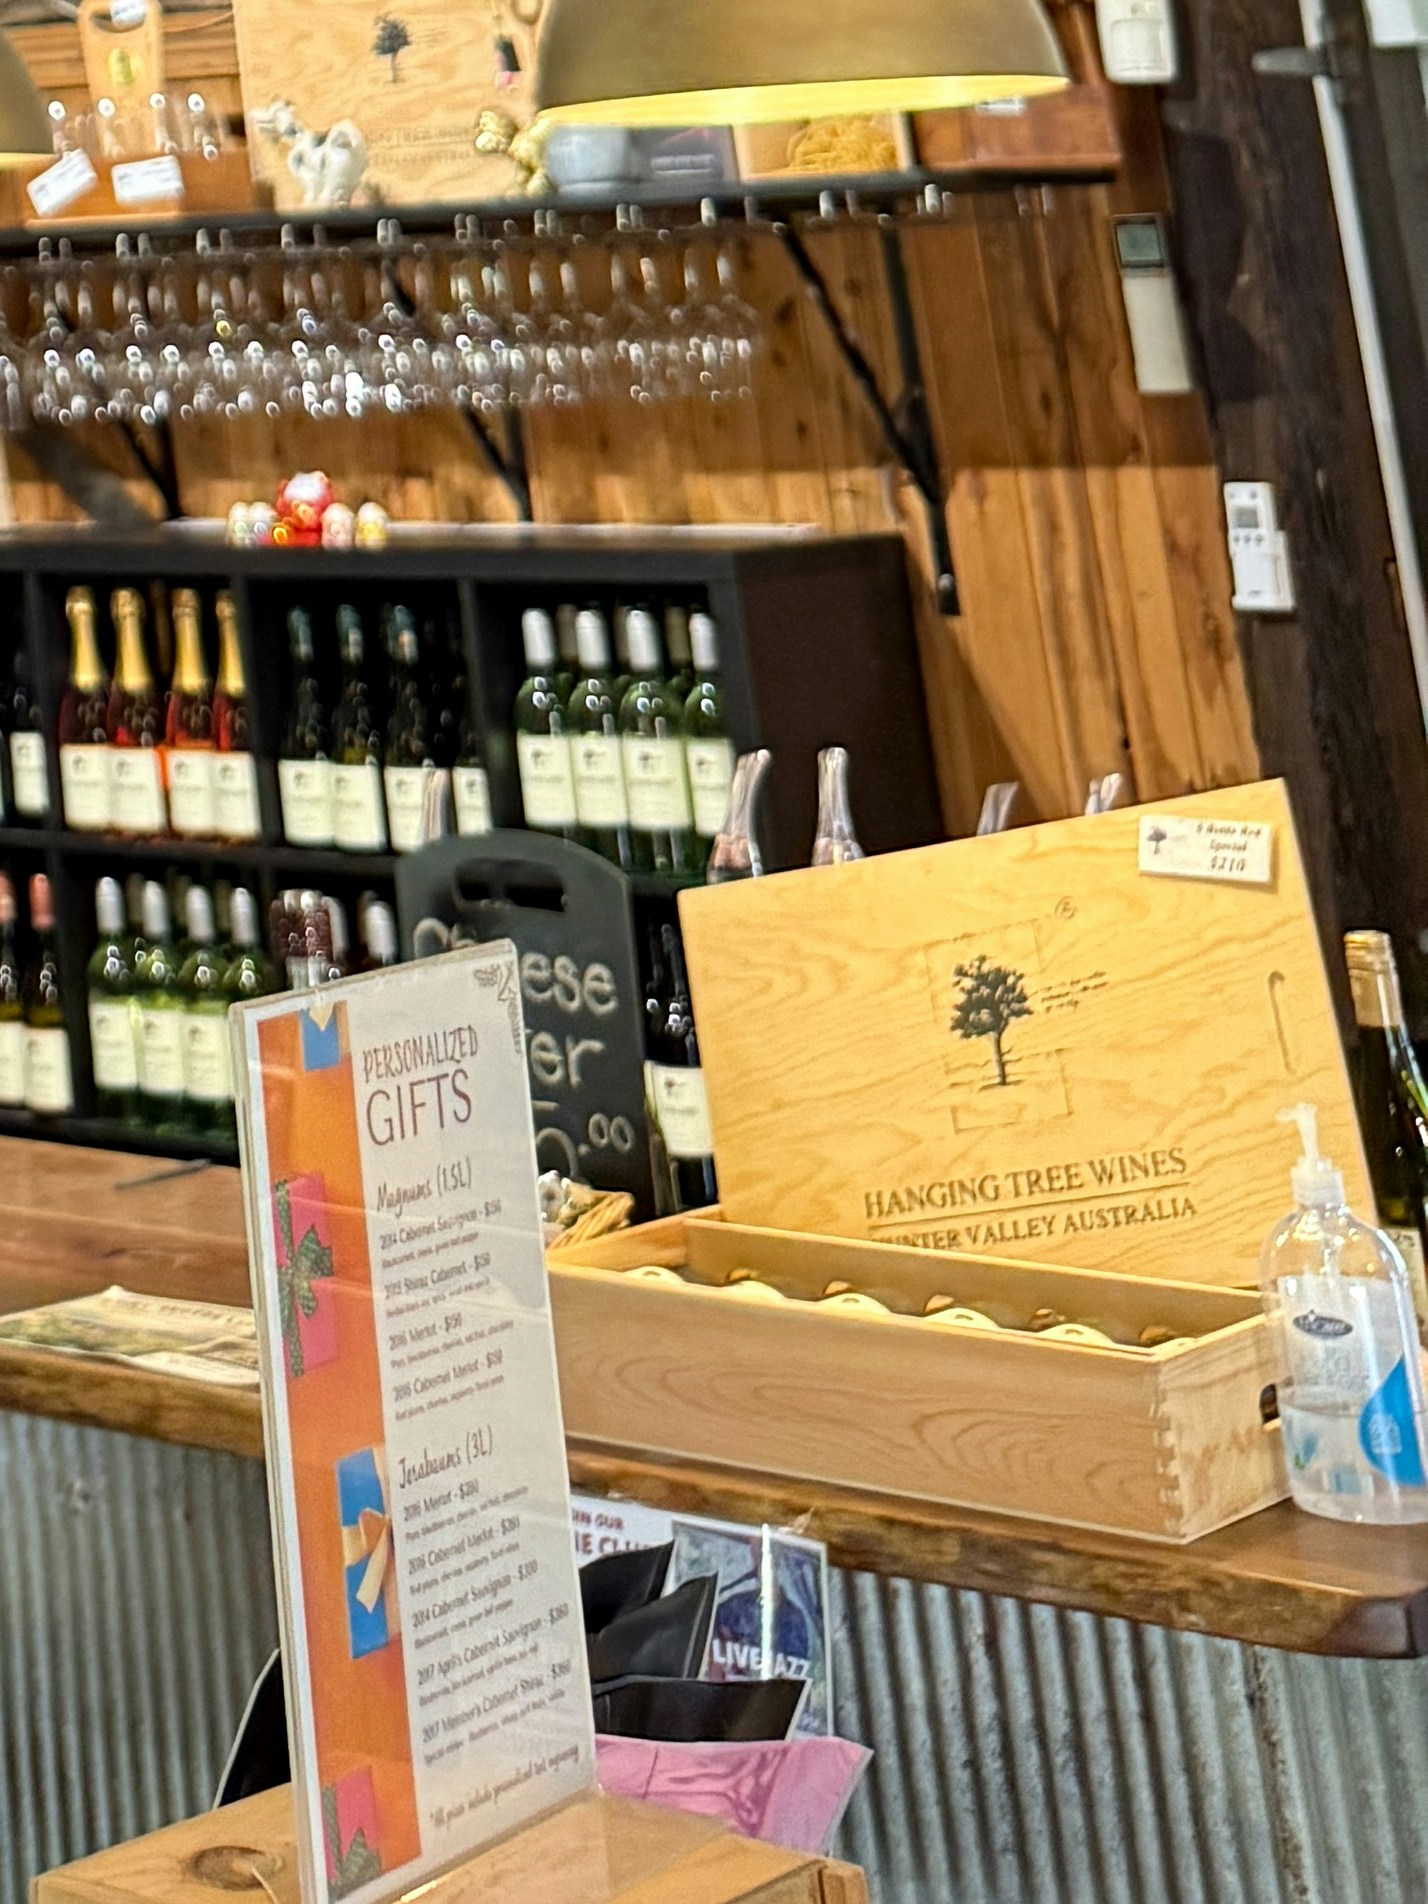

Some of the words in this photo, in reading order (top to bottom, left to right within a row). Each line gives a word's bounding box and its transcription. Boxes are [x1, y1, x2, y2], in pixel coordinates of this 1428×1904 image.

[362, 1024, 479, 1084] PERSONALIZED
[366, 1068, 472, 1146] GIFTS
[376, 1178, 433, 1219] Magnums
[863, 1173, 1000, 1219] HANGING
[1004, 1161, 1084, 1200] TREE
[1087, 1146, 1188, 1186] WINES
[966, 1214, 1058, 1247] VALLEY
[1062, 1195, 1199, 1234] AUSTRALIA
[467, 1422, 493, 1465] (3L)
[711, 1638, 763, 1670] LIVE
